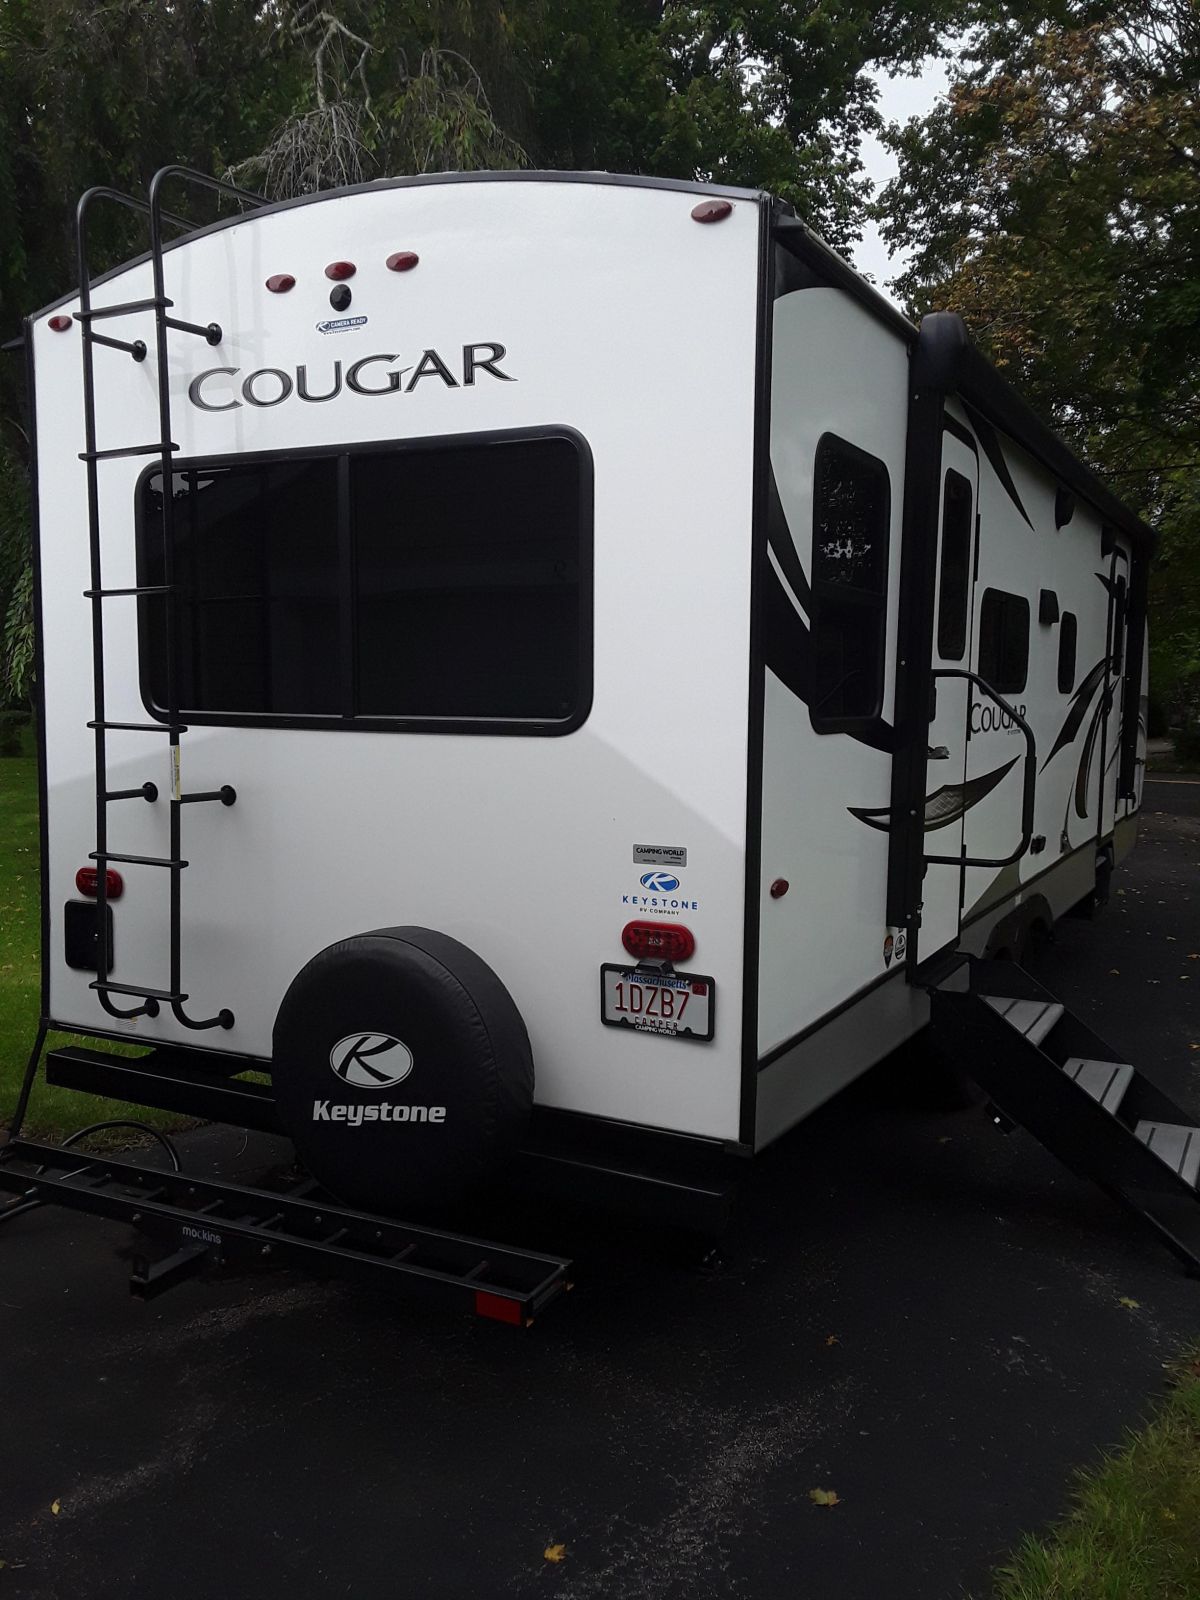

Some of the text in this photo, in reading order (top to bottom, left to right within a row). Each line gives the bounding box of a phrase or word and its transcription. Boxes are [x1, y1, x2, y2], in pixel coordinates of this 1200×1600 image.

[331, 317, 366, 328] CAMERA READY
[188, 342, 519, 412] COUGAR
[636, 847, 662, 855] CAMPING
[622, 895, 698, 910] KEYSTONE
[650, 908, 680, 916] COMPANY
[626, 973, 687, 990] Massachusetts
[615, 982, 690, 1021] 1DZB7
[634, 1016, 679, 1031] CAMPER
[635, 1024, 677, 1036] CAMPING WORLD
[313, 1100, 446, 1127] Keystone
[182, 1226, 222, 1244] mockins
